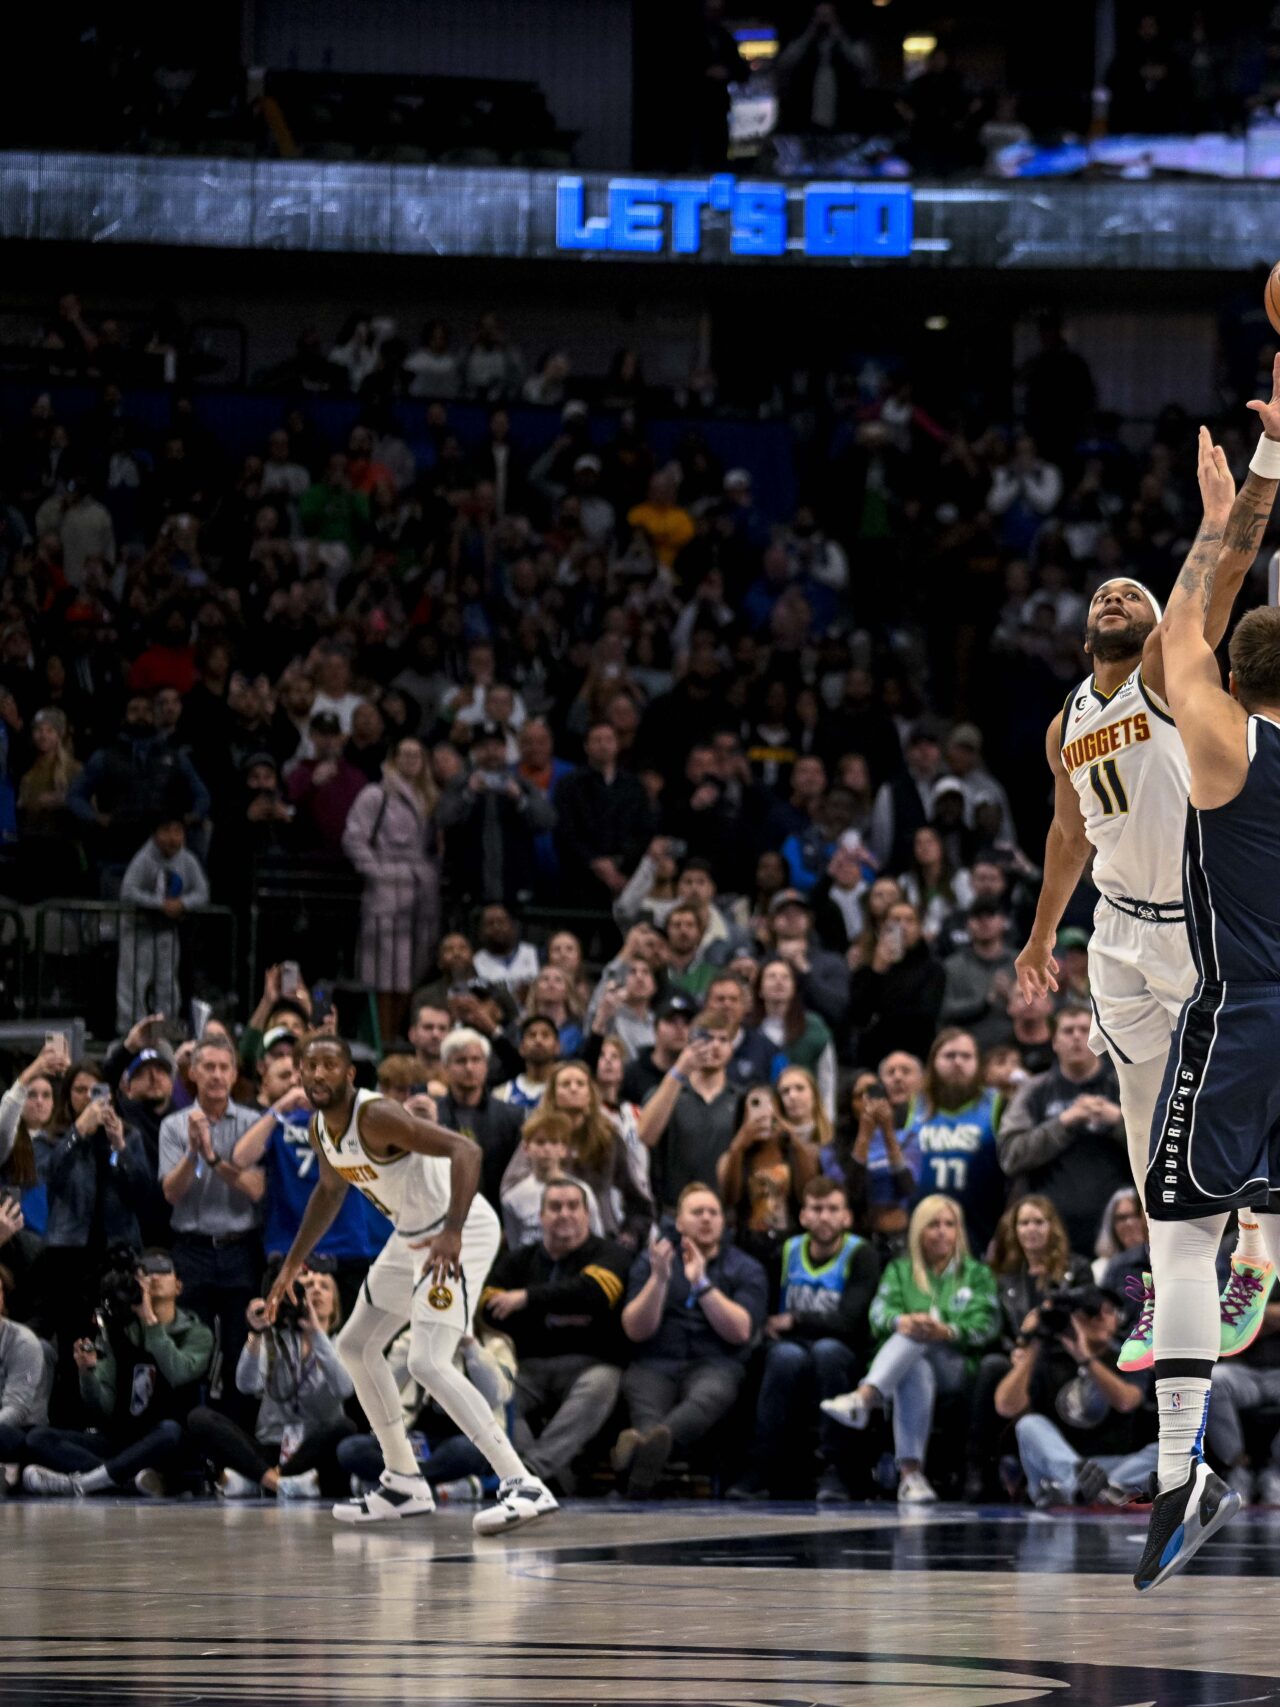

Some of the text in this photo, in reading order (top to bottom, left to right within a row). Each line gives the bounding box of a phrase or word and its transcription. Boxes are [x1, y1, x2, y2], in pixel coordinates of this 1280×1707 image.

[556, 173, 913, 256] LET'S GO
[1061, 712, 1151, 775] NUGGETS
[1089, 758, 1129, 815] 11
